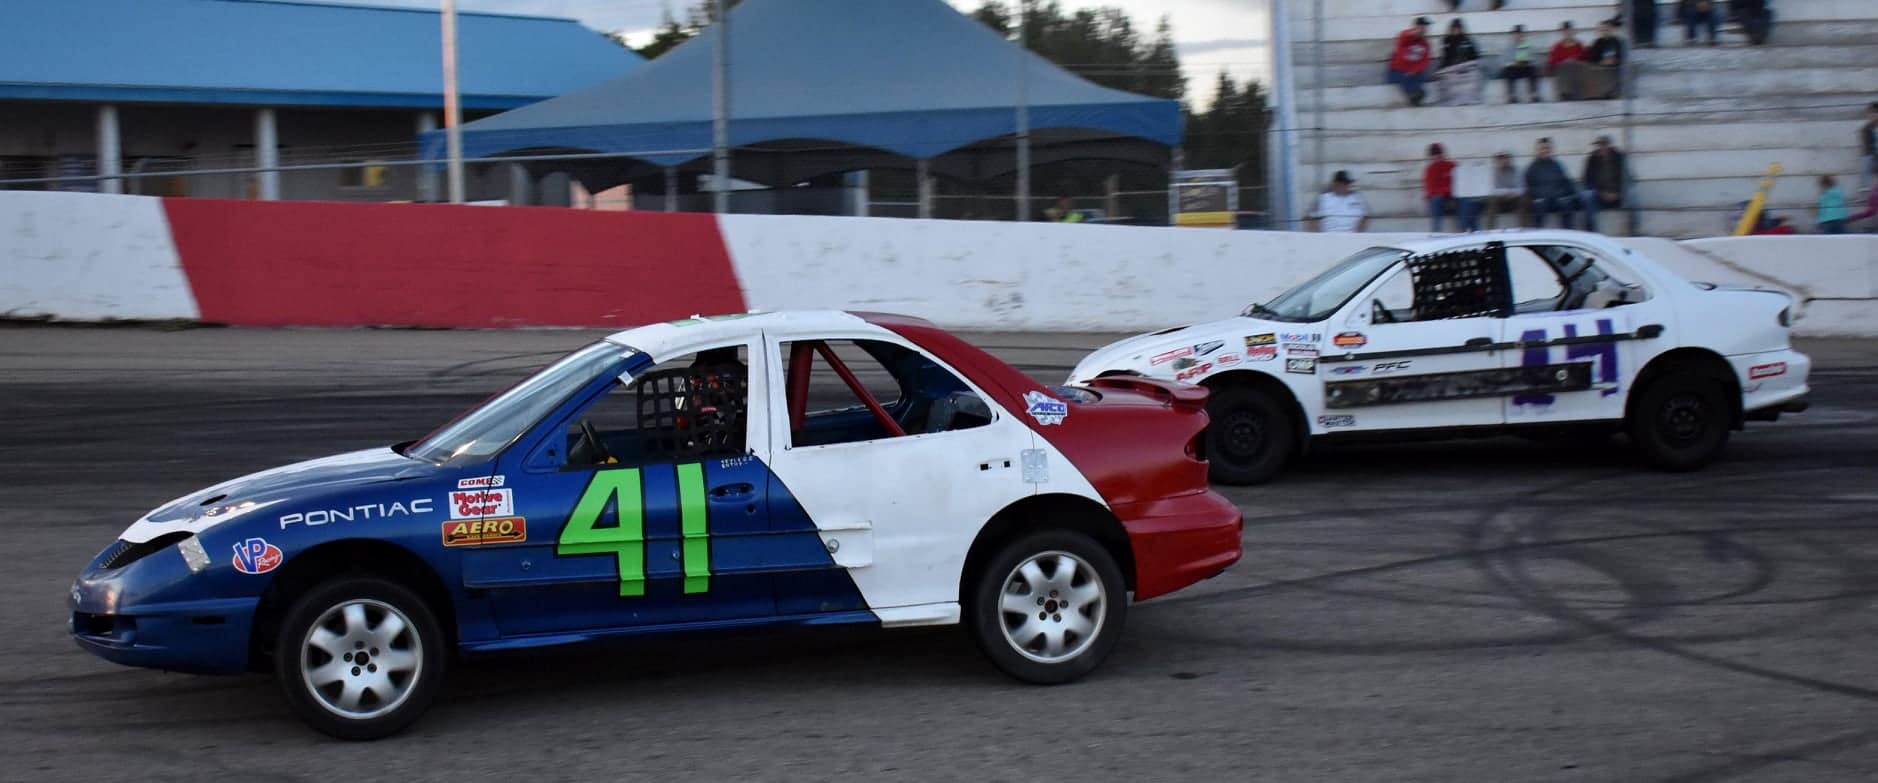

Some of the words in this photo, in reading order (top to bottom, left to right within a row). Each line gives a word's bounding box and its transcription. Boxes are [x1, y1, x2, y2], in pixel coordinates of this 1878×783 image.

[1374, 360, 1412, 371] PFC
[453, 491, 503, 505] Motive
[279, 498, 434, 530] PONTIAC
[458, 502, 498, 517] Gear
[451, 520, 514, 534] AERO
[557, 462, 711, 597] 41
[233, 537, 268, 574] VP
